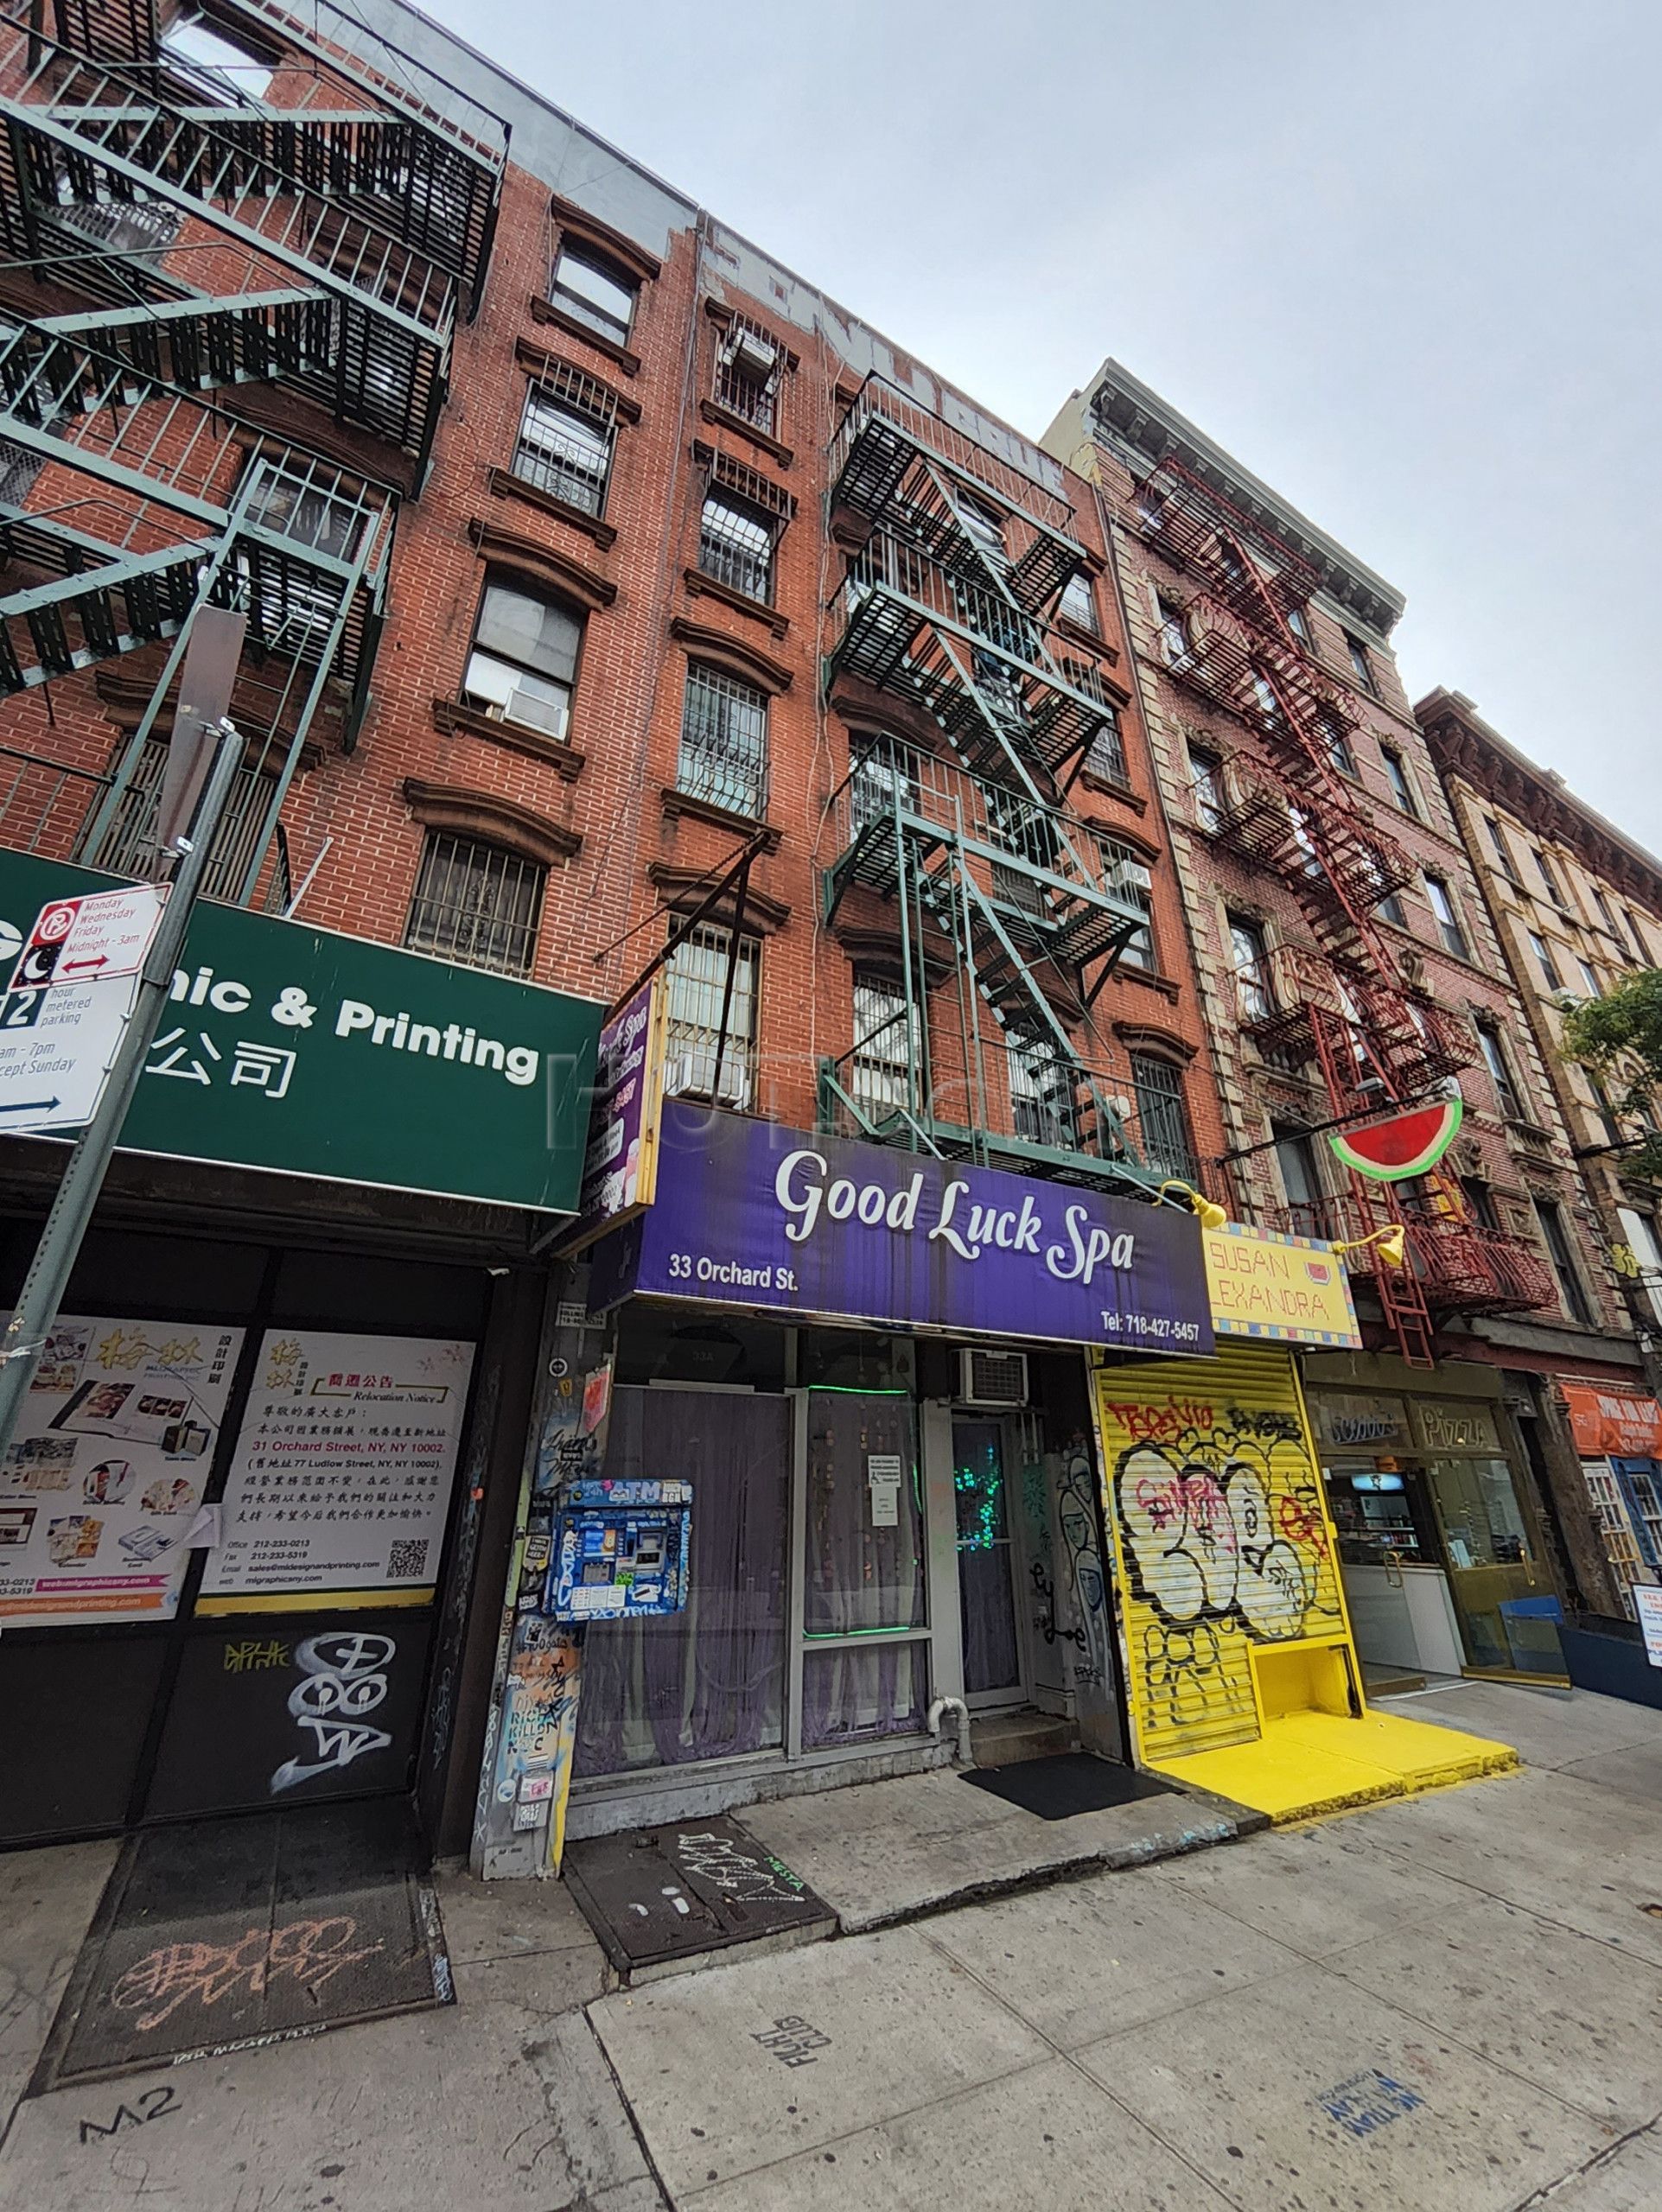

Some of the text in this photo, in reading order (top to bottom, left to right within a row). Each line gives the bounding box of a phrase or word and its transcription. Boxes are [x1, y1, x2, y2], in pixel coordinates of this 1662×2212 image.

[84, 899, 124, 912] Monday
[80, 908, 136, 924] Wednesday
[74, 925, 104, 938] Friday
[68, 939, 109, 954] Midnight
[117, 933, 140, 946] 3am
[51, 988, 75, 1000] hour
[6, 990, 37, 1026] 2
[46, 996, 92, 1013] metered
[40, 1012, 81, 1029] parking
[271, 987, 314, 1029] &
[335, 998, 539, 1086] Printing
[29, 1042, 55, 1058] 7pm
[29, 1058, 77, 1074] Sunday
[145, 1027, 296, 1099] 公司
[774, 1149, 1135, 1285] Good Luck Spa
[1209, 1242, 1289, 1280] SUSAN
[668, 1253, 799, 1293] 33 Orchard St.
[1211, 1280, 1330, 1320] EXANDRA
[1100, 1309, 1200, 1343] Tel: 718-427-5457
[353, 1390, 436, 1403] Relocation Notice
[252, 1441, 446, 1454] 31 Orchard Street, NY, NY 10002.
[309, 1459, 343, 1468] Ludlow
[345, 1460, 375, 1470] Street,
[377, 1460, 393, 1470] NY,
[394, 1460, 409, 1469] NY
[253, 1540, 310, 1549] 212-233-0213
[764, 1856, 805, 1891] MESTA
